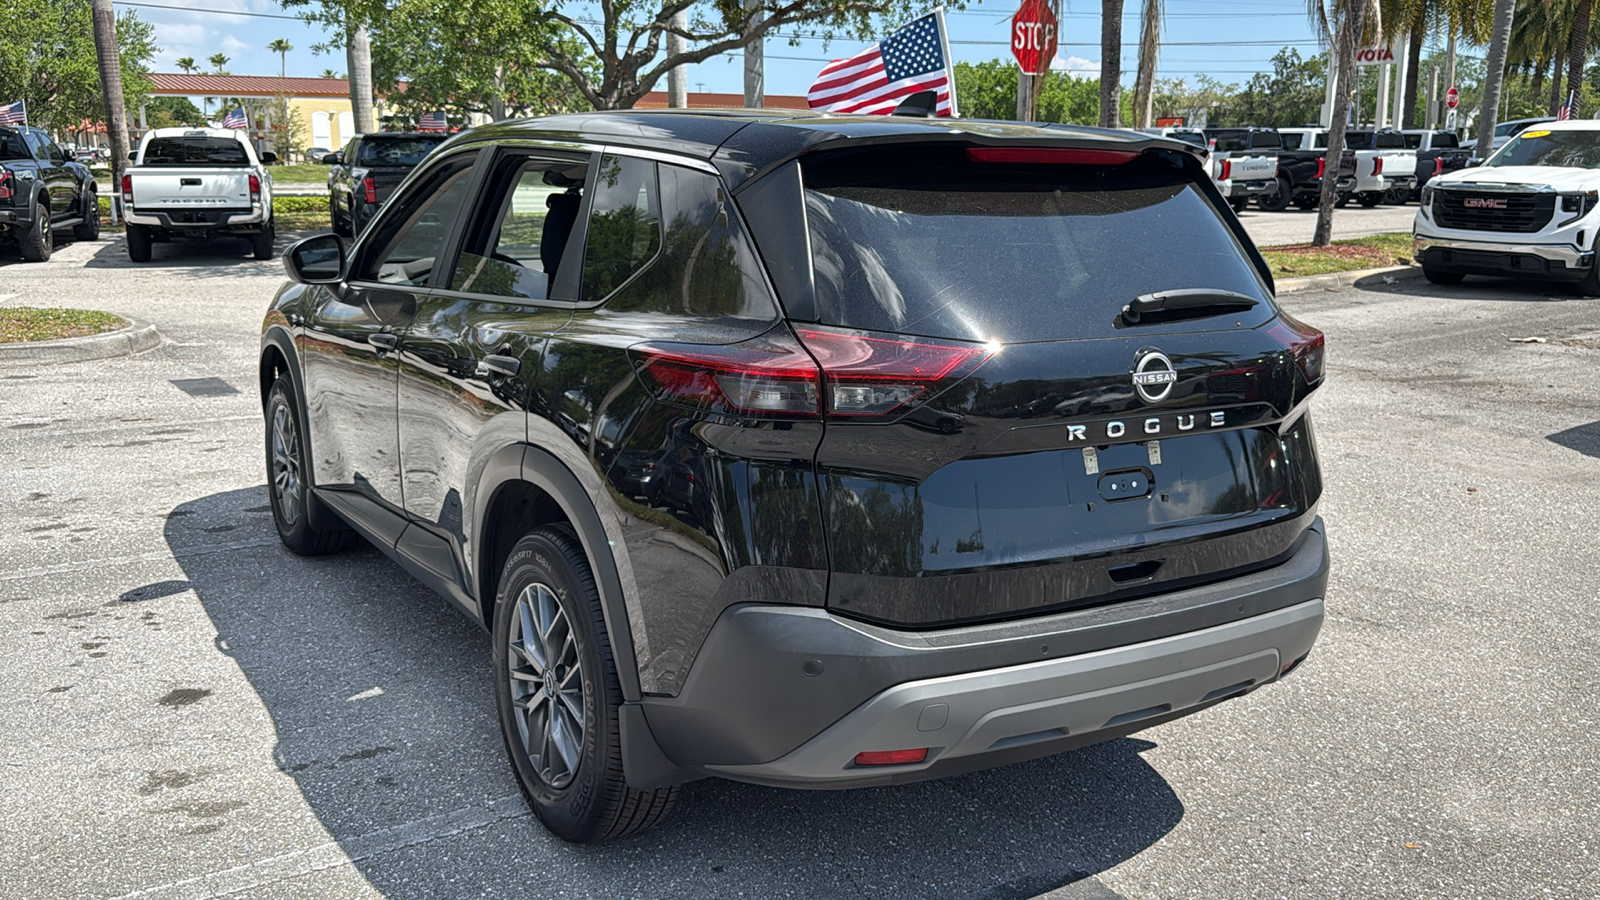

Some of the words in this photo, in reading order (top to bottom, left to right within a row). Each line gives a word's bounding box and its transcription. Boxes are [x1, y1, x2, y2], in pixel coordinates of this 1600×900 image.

[1015, 21, 1054, 50] STOP
[1357, 48, 1394, 61] YOTA
[1463, 198, 1507, 208] GMC
[1133, 373, 1176, 384] NISSAN
[1067, 411, 1225, 441] ROGUE
